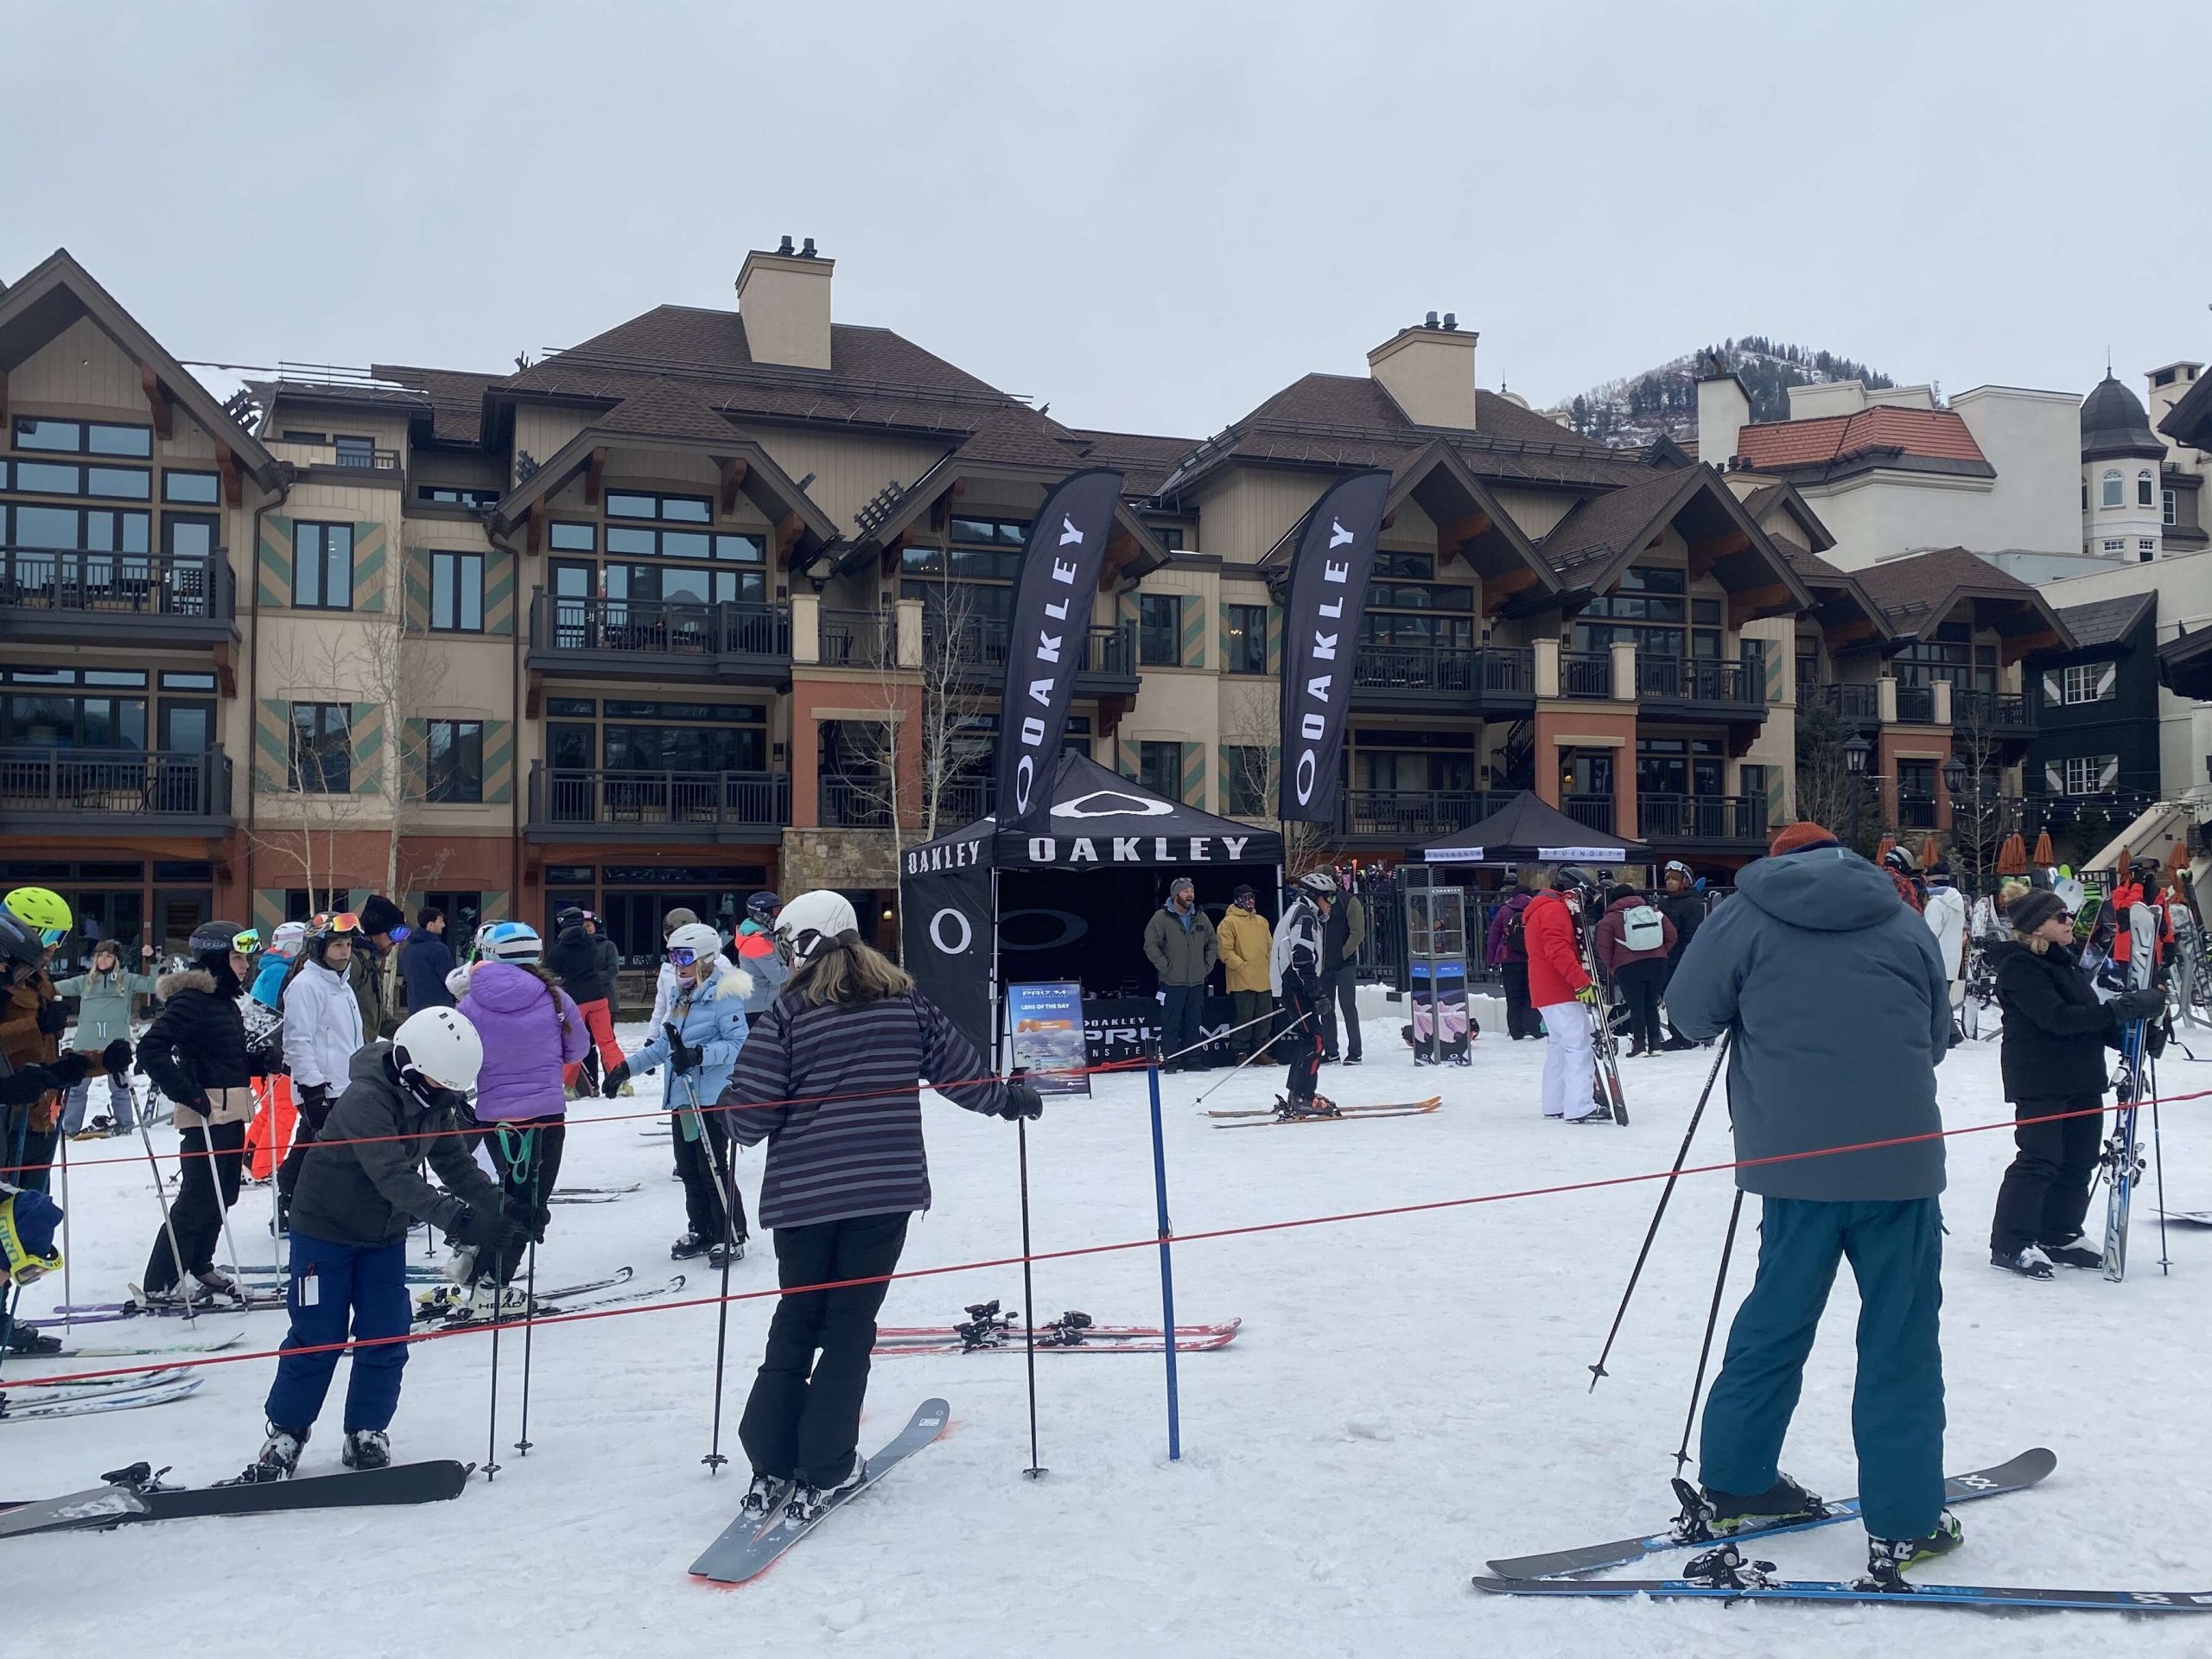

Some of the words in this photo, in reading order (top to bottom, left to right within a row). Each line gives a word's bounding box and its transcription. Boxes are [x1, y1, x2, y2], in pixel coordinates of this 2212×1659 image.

[1021, 517, 1084, 747] OAKLEY
[1301, 520, 1355, 741] OAKLEY
[908, 840, 980, 874] OAKLEY
[1028, 836, 1249, 862] OAKLEY
[1090, 1016, 1146, 1027] OAKLEY
